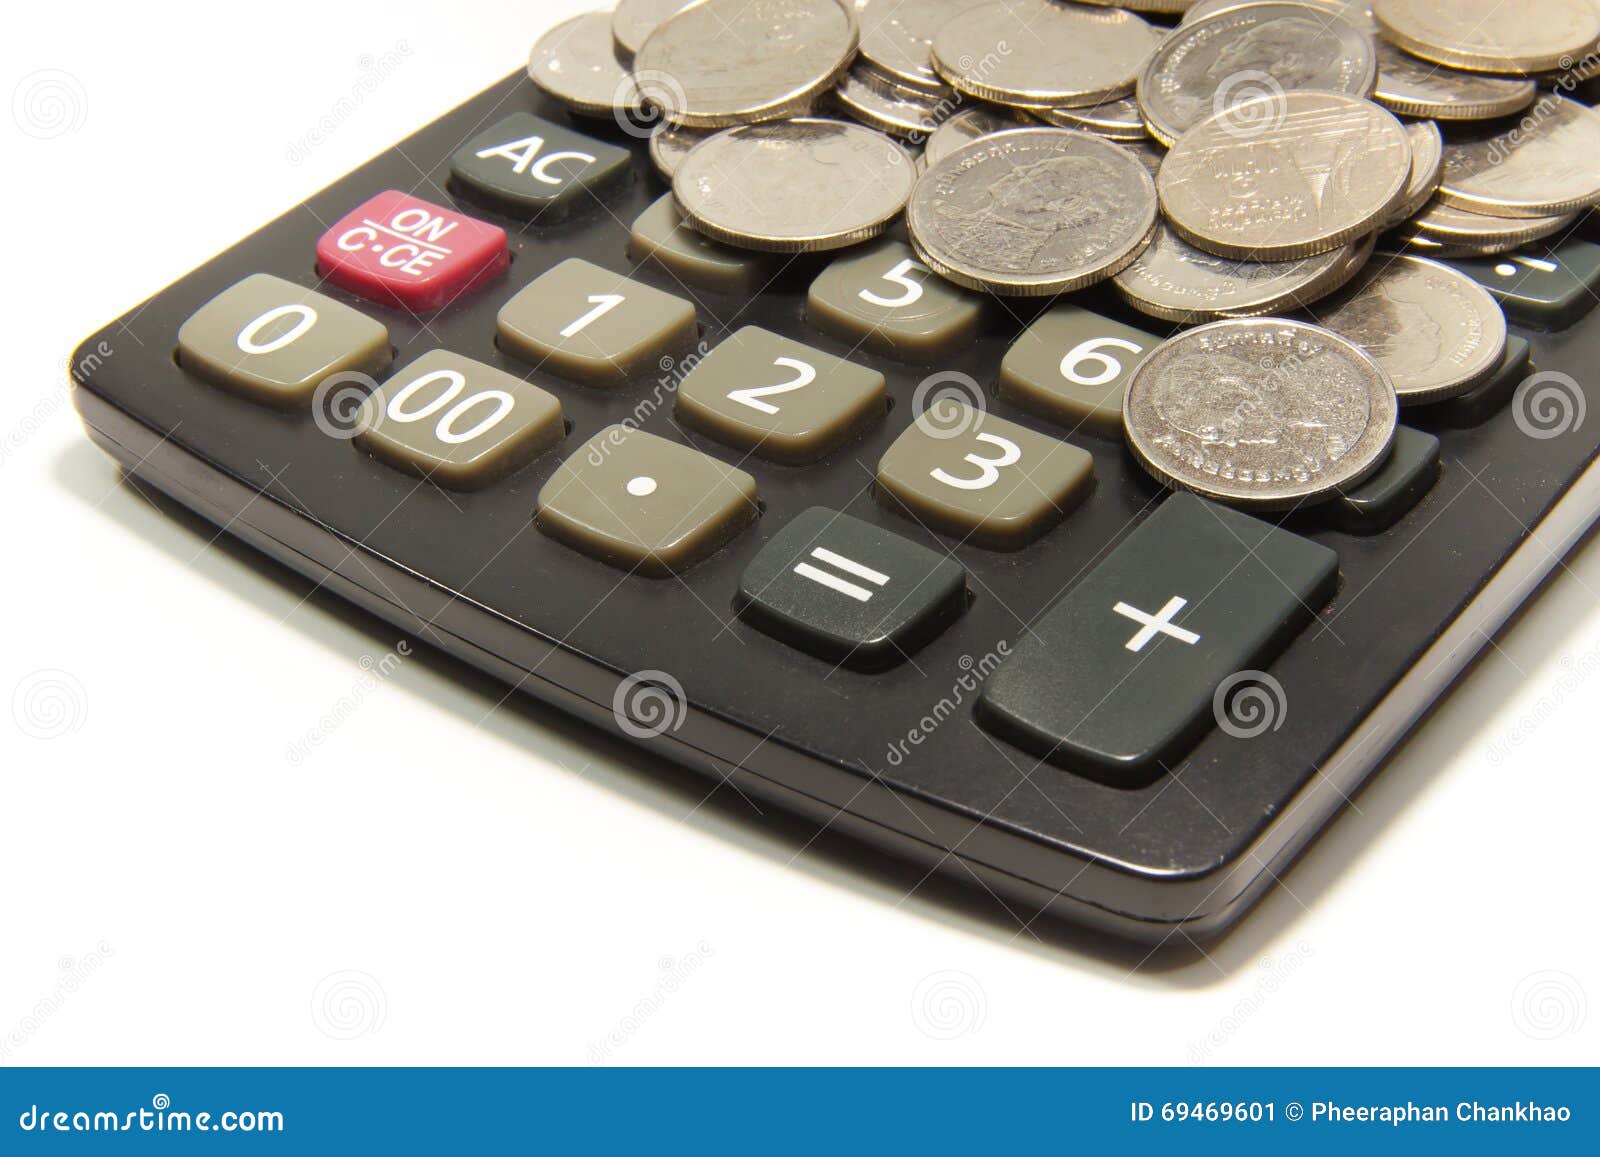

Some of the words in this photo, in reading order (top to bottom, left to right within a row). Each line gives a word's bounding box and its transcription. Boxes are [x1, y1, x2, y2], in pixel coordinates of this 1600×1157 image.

[475, 135, 597, 184] AC
[390, 208, 459, 242] ON
[858, 258, 931, 307] 5
[236, 303, 317, 354] 0
[559, 294, 625, 338] 1
[726, 356, 816, 414] 2
[1059, 337, 1143, 386] 6
[387, 369, 515, 444] 00
[930, 432, 1021, 490] 3
